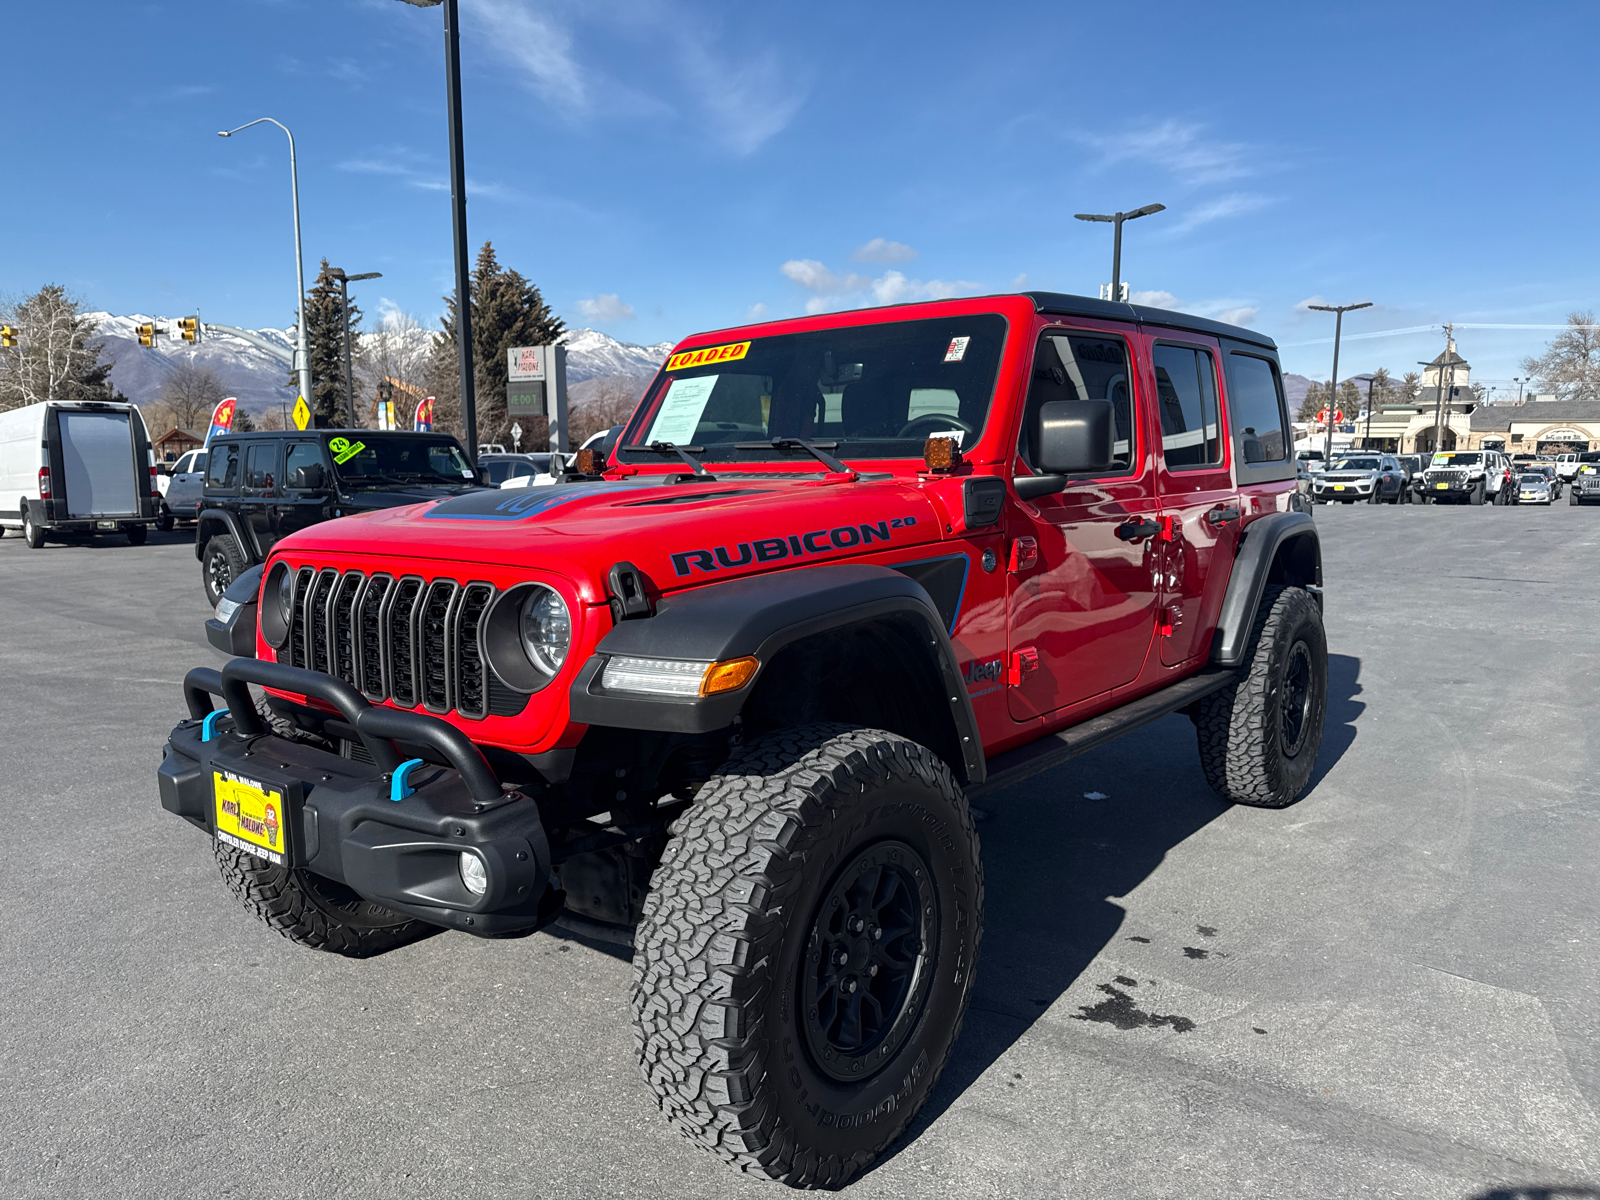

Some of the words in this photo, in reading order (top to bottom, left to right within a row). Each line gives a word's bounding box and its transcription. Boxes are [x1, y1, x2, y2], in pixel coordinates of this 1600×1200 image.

[669, 344, 745, 368] LOADED
[669, 520, 892, 577] RUBICON
[963, 659, 1003, 685] Jeep
[222, 799, 238, 817] KARL
[241, 815, 265, 837] MALONE
[782, 1034, 930, 1130] BFGoodrich
